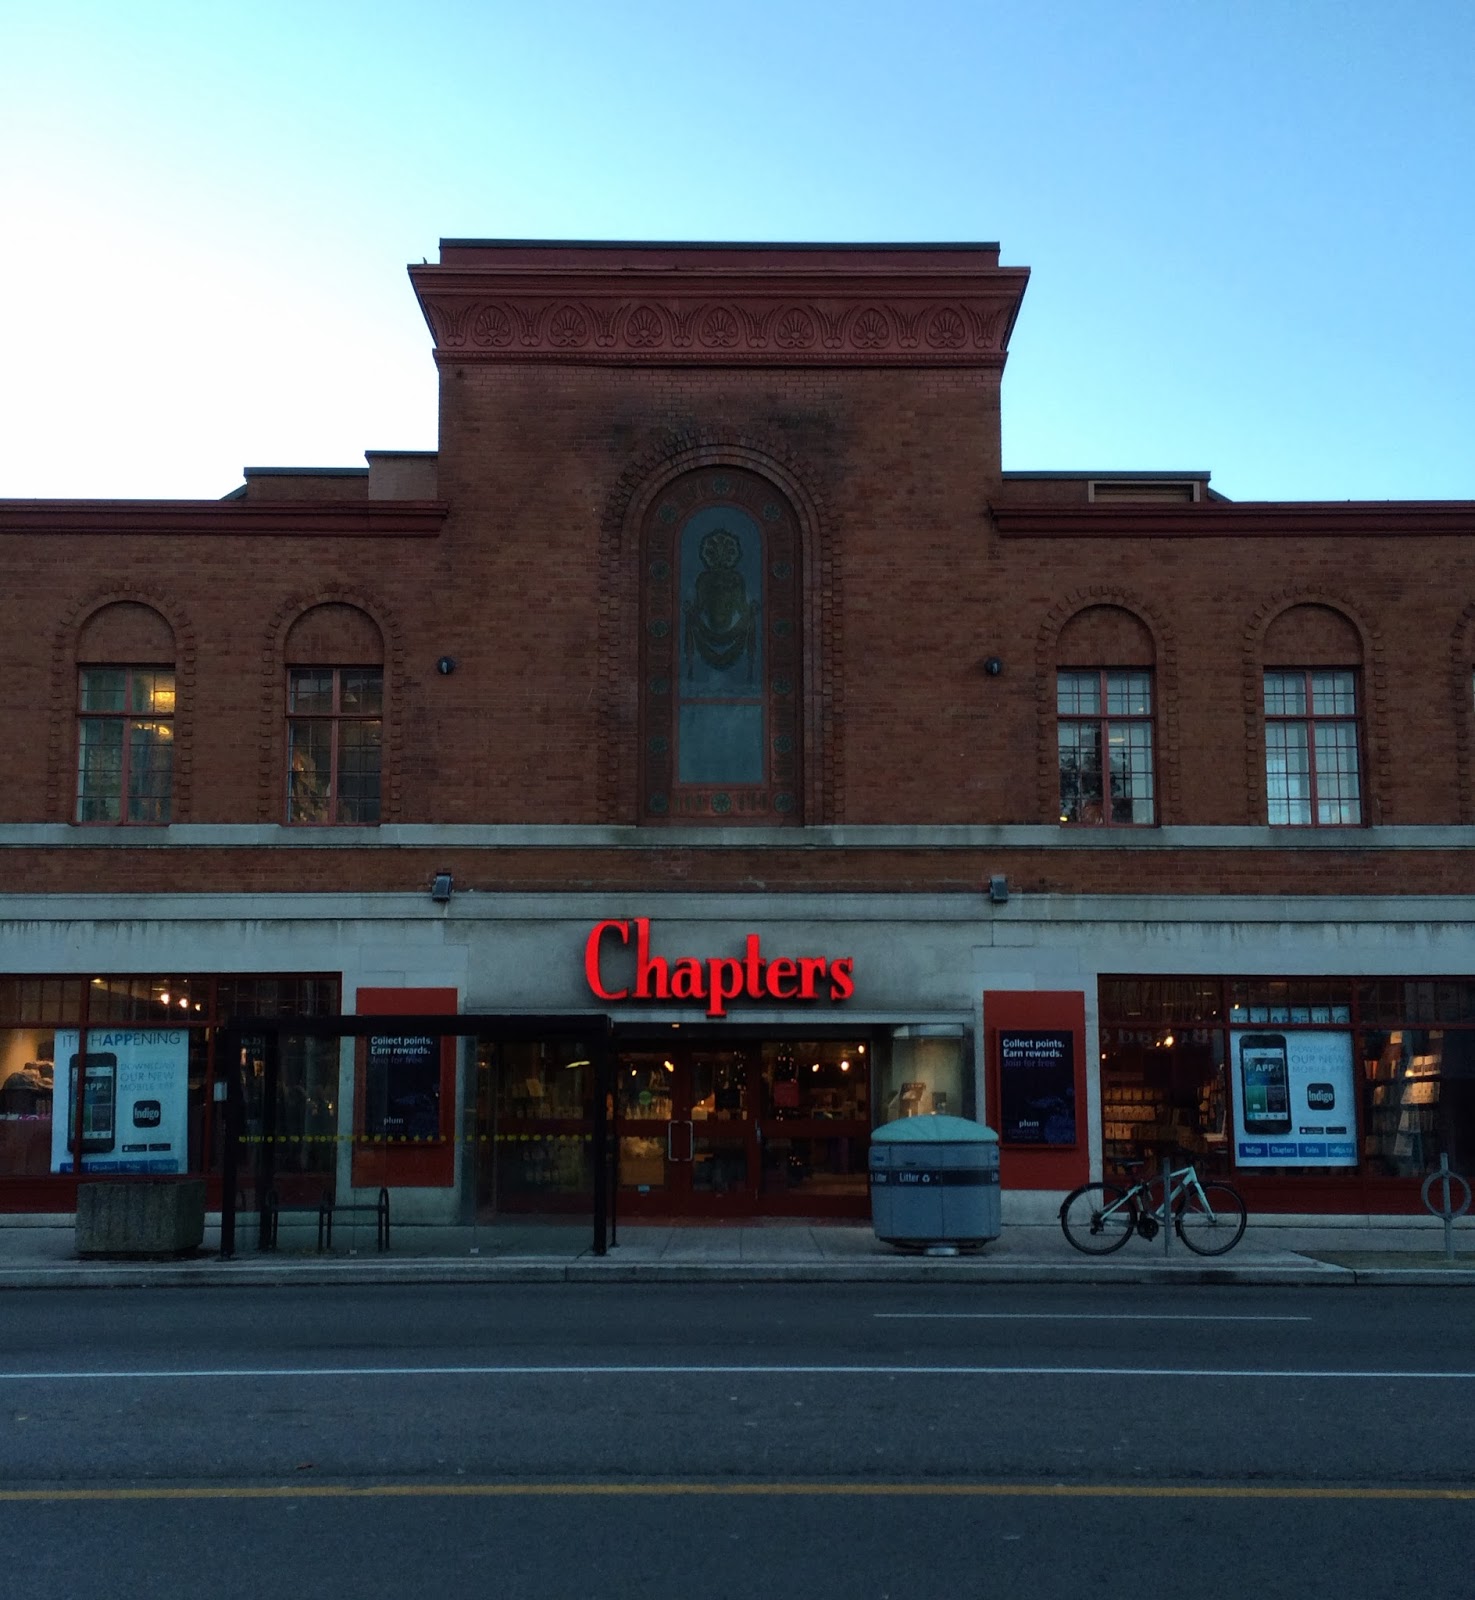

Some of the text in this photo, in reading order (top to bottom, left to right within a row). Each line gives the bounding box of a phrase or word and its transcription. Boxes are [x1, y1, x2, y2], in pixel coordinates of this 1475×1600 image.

[584, 917, 855, 1017] Chapters
[91, 1031, 181, 1046] HAPPENING
[371, 1036, 433, 1046] Collect points.
[1003, 1038, 1065, 1050] Collect points.
[371, 1046, 431, 1054] Earn rewards.
[1003, 1048, 1063, 1057] Earn rewards.
[120, 1071, 175, 1081] OUR NEW
[1308, 1090, 1333, 1103] Indigo
[134, 1107, 159, 1120] Indigo
[384, 1116, 404, 1126] plum
[1019, 1119, 1039, 1128] plum
[899, 1172, 919, 1183] Litter
